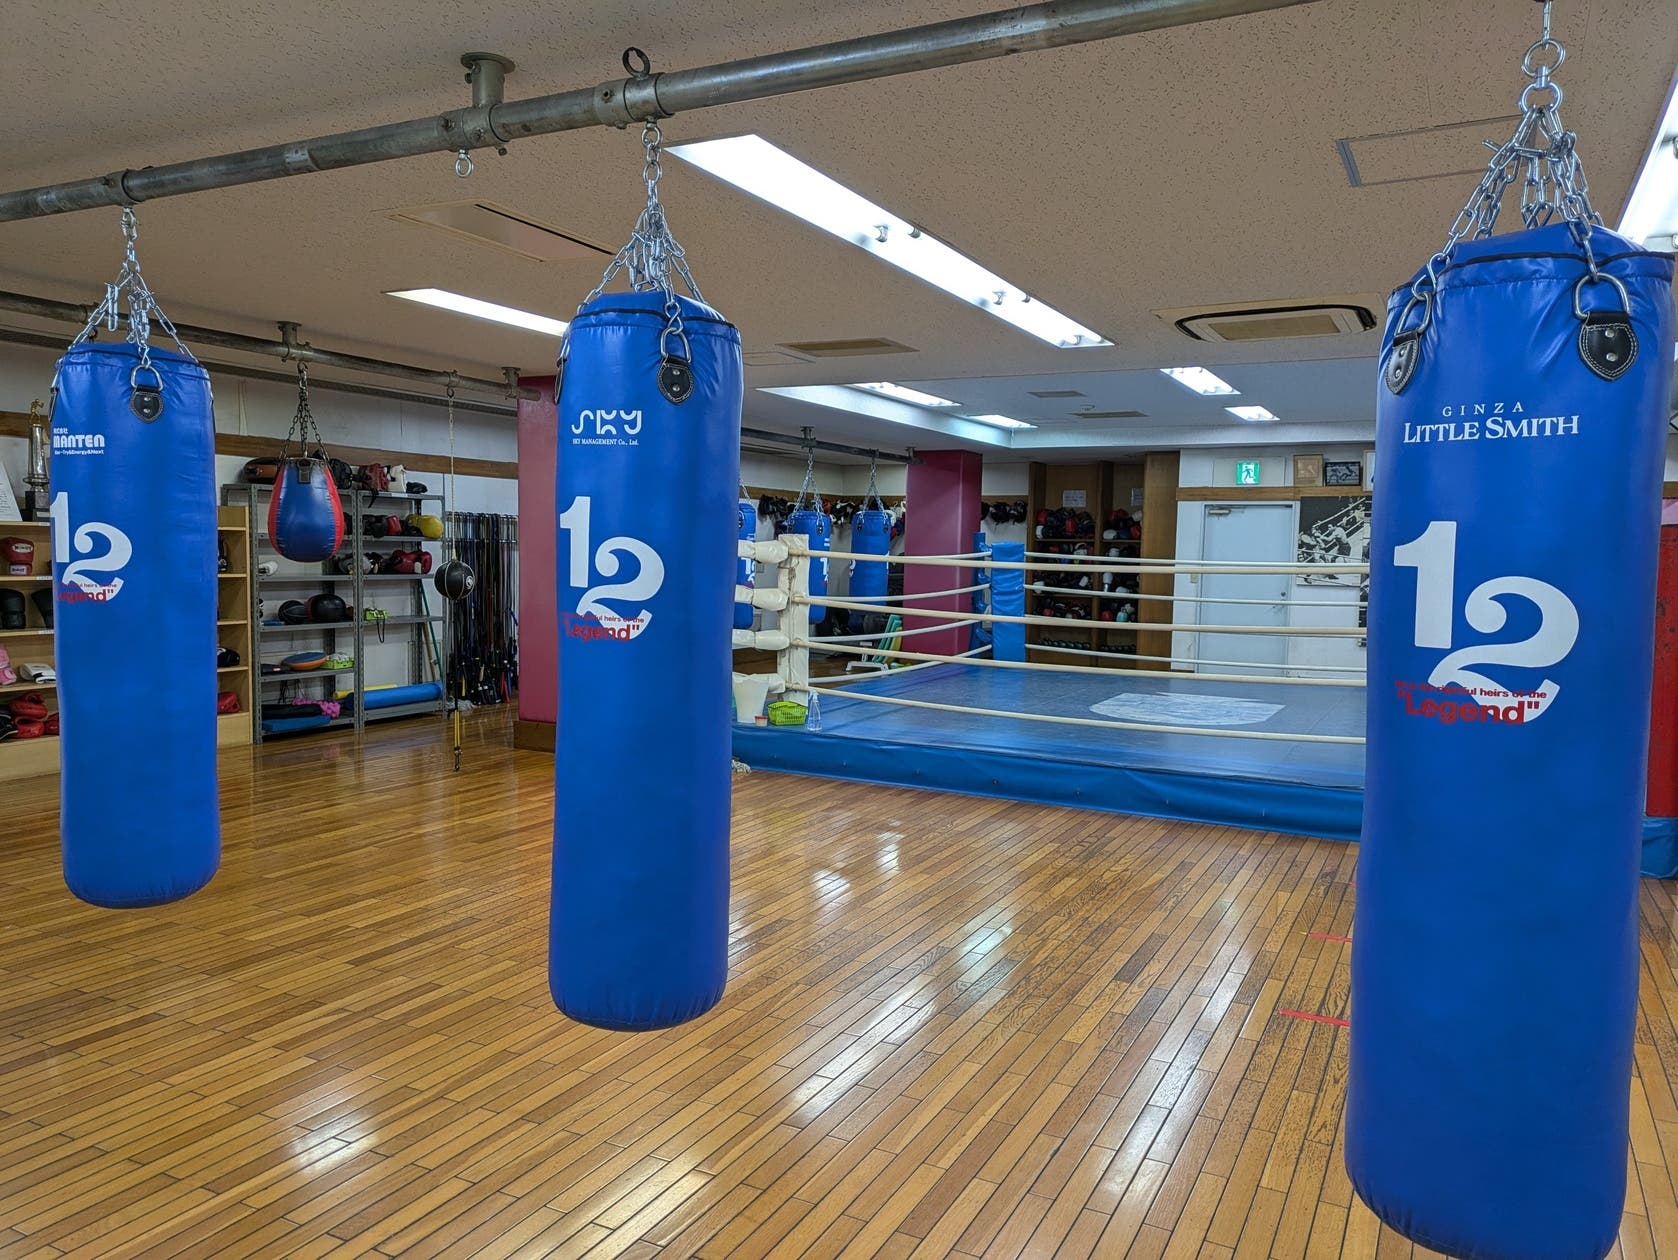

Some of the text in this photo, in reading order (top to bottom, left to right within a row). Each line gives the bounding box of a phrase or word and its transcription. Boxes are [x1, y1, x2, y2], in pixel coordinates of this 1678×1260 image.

[1442, 402, 1525, 417] GINZA
[1403, 415, 1580, 443] LITTLE SMITH
[581, 438, 617, 446] MANAGEMENT
[560, 496, 665, 640] 12
[1394, 520, 1579, 723] 12
[1480, 687, 1509, 698] heirs
